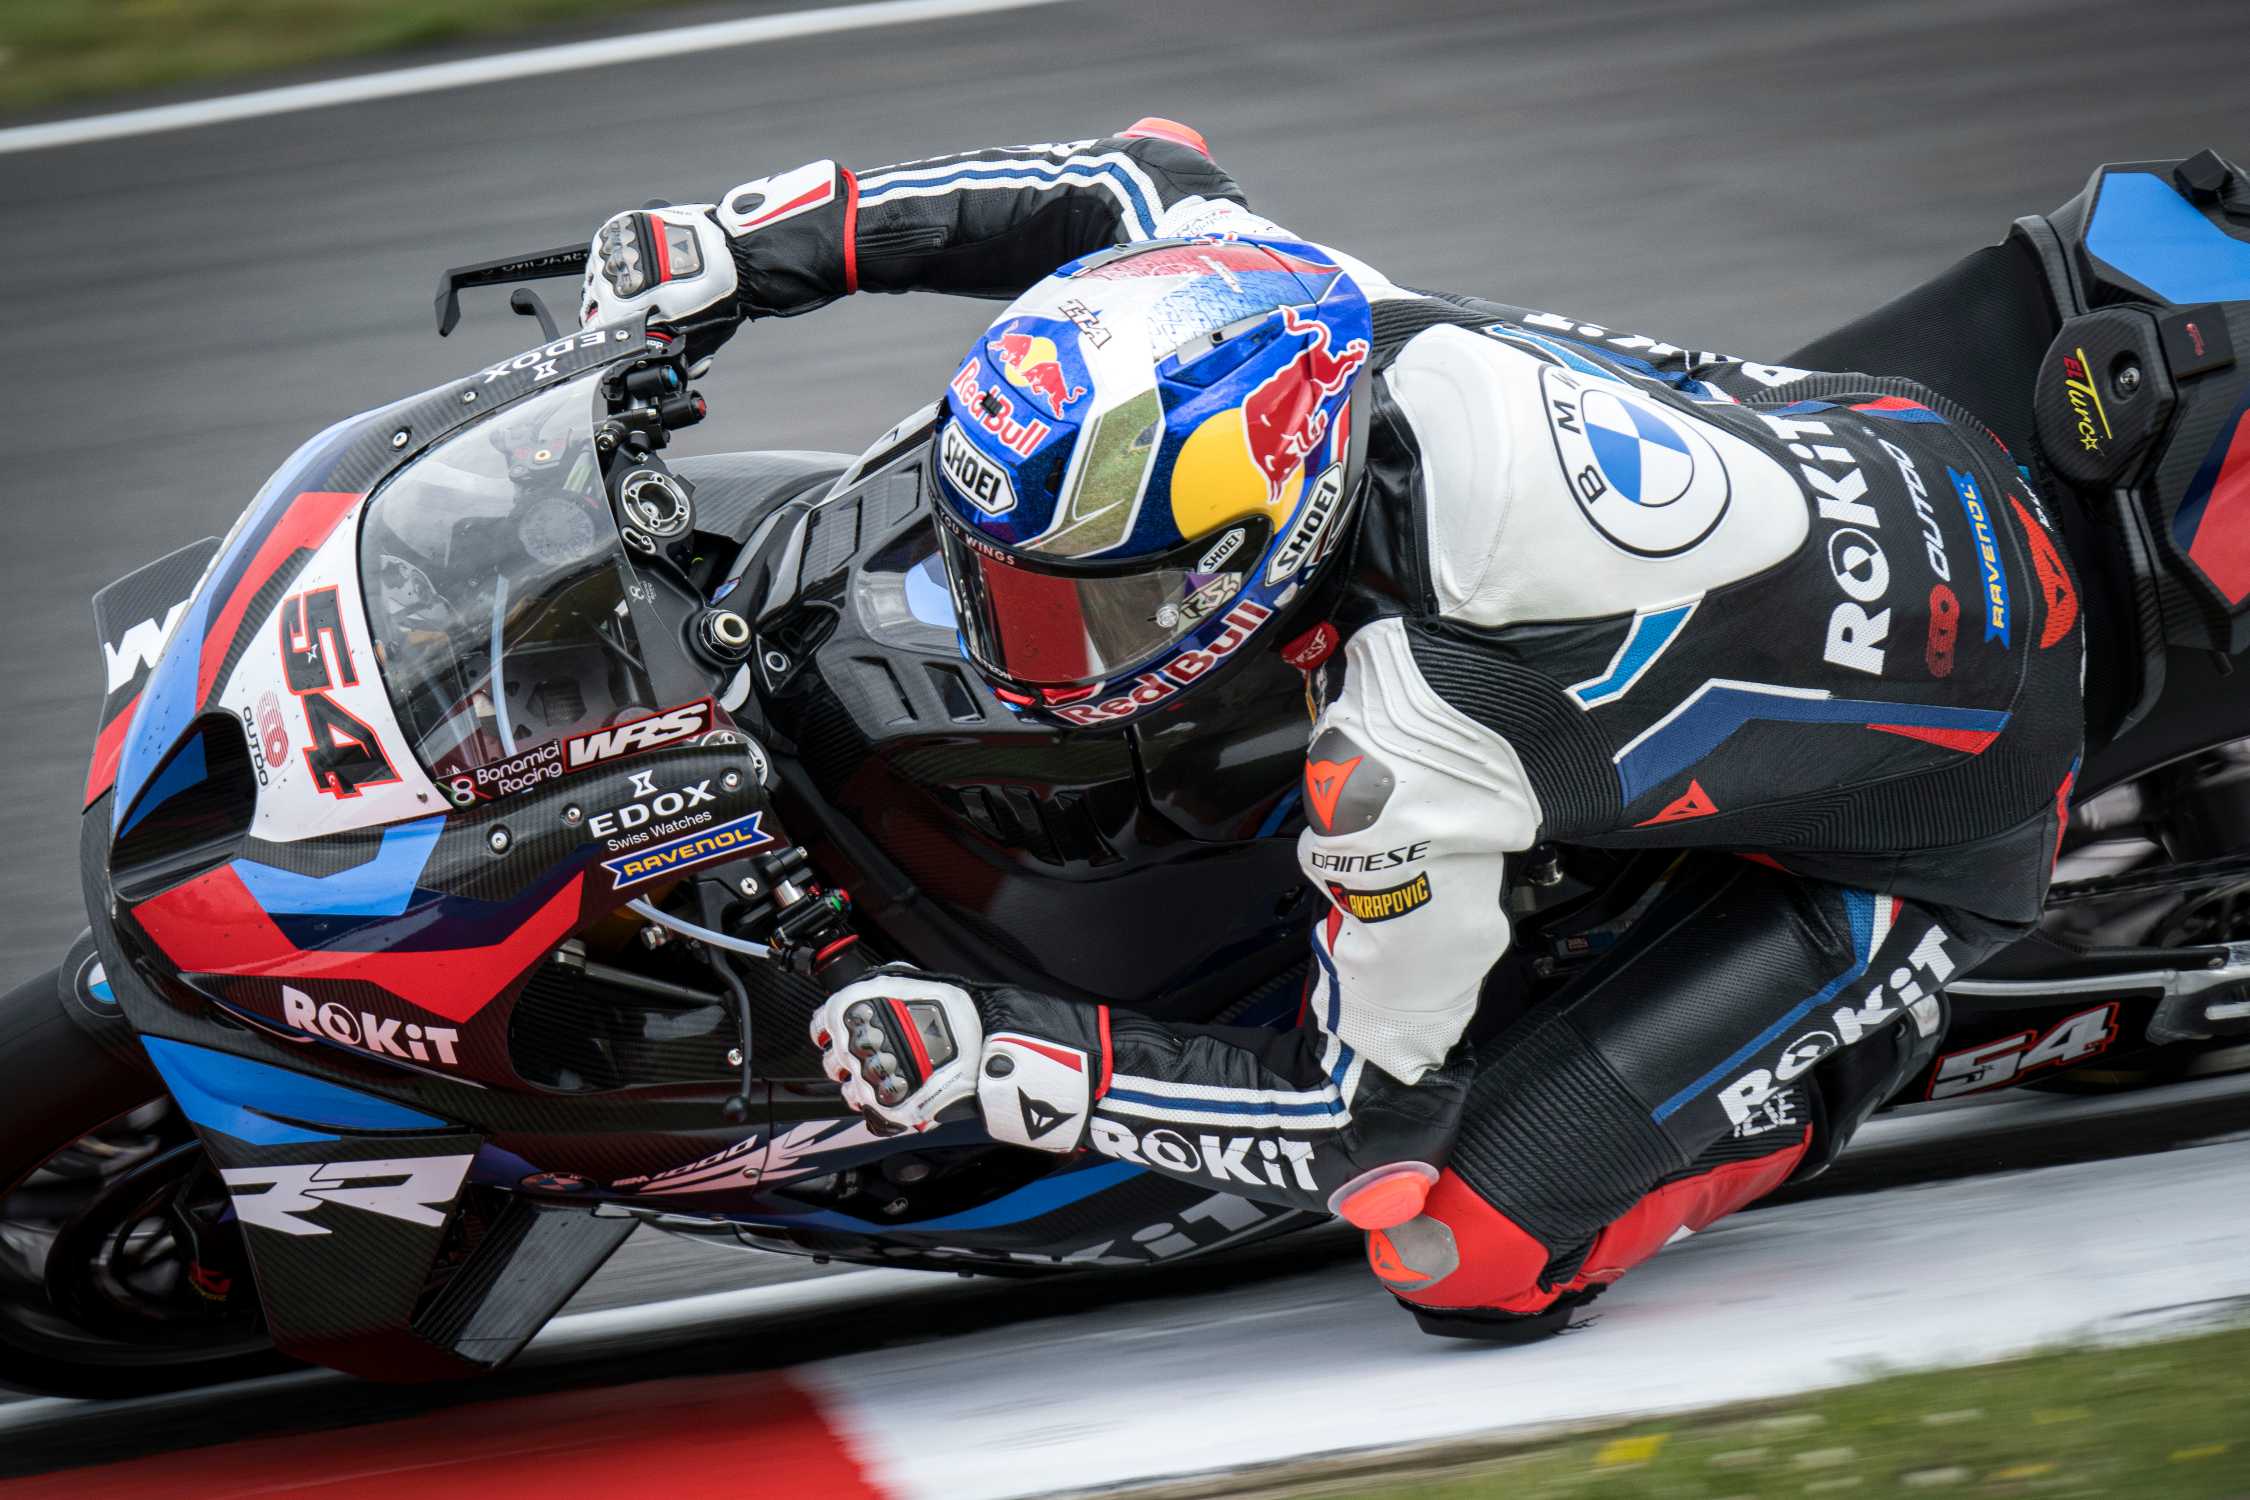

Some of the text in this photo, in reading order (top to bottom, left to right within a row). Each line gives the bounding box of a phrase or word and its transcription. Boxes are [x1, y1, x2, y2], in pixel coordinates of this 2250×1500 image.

[483, 331, 606, 384] EDOX
[944, 432, 1001, 506] SHOEI
[1277, 481, 1337, 571] SHOEI
[1877, 438, 1951, 582] OUTDO
[965, 534, 1015, 566] WINGS
[1203, 534, 1240, 570] SHOEI
[1960, 484, 2005, 629] RAVENOL
[280, 584, 404, 800] 54
[1052, 673, 1179, 726] Red
[1160, 598, 1274, 686] Bull
[243, 704, 269, 787] OUTDO
[476, 741, 561, 786] Bonamici
[569, 702, 709, 767] WRS
[498, 762, 563, 796] Racing
[588, 779, 717, 838] EDOX
[607, 810, 713, 852] Swiss Watches
[622, 826, 753, 878] RAVENOL
[1311, 840, 1432, 873] DAINESE
[1926, 1002, 2119, 1100] 54
[220, 1153, 475, 1236] RR
